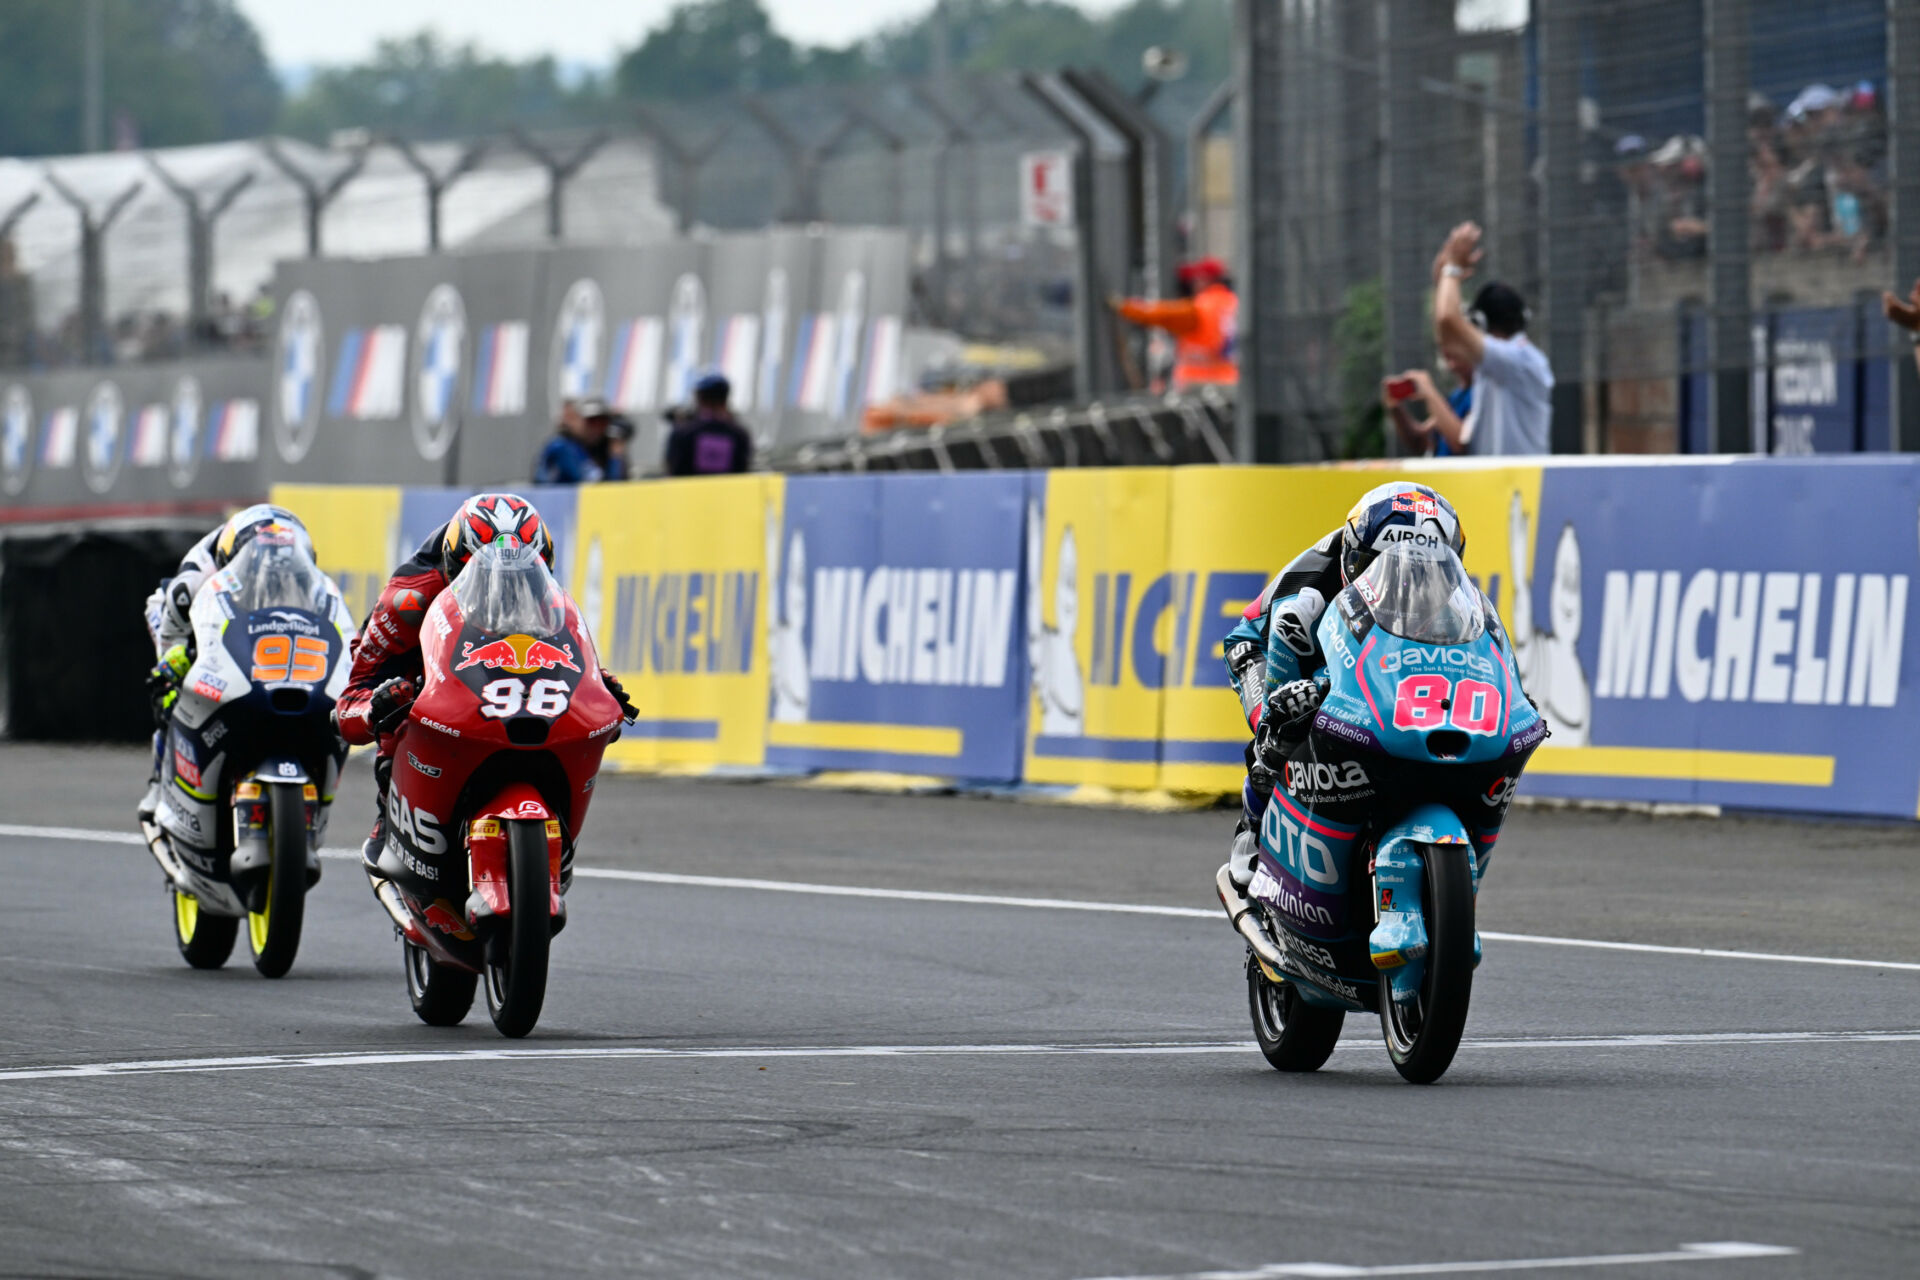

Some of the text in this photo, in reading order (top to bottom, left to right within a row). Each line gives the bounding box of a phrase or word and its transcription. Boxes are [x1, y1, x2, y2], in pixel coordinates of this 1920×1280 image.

[1392, 501, 1439, 517] Red Bull
[1382, 529, 1438, 549] AIROH
[611, 571, 760, 674] MICHELIN
[811, 565, 1017, 687] MICHELIN
[1595, 569, 1909, 707] MICHELIN
[251, 634, 329, 683] 95
[1326, 615, 1356, 669] CFMOTO
[1380, 647, 1495, 675] gaviota
[480, 678, 571, 718] 96
[1393, 673, 1502, 738] 80
[420, 716, 461, 738] GASGAS
[1327, 720, 1370, 745] solunion
[1285, 760, 1370, 797] gaviota
[1338, 788, 1375, 803] Specialists
[404, 849, 415, 872] THE
[416, 859, 440, 881] GAS!
